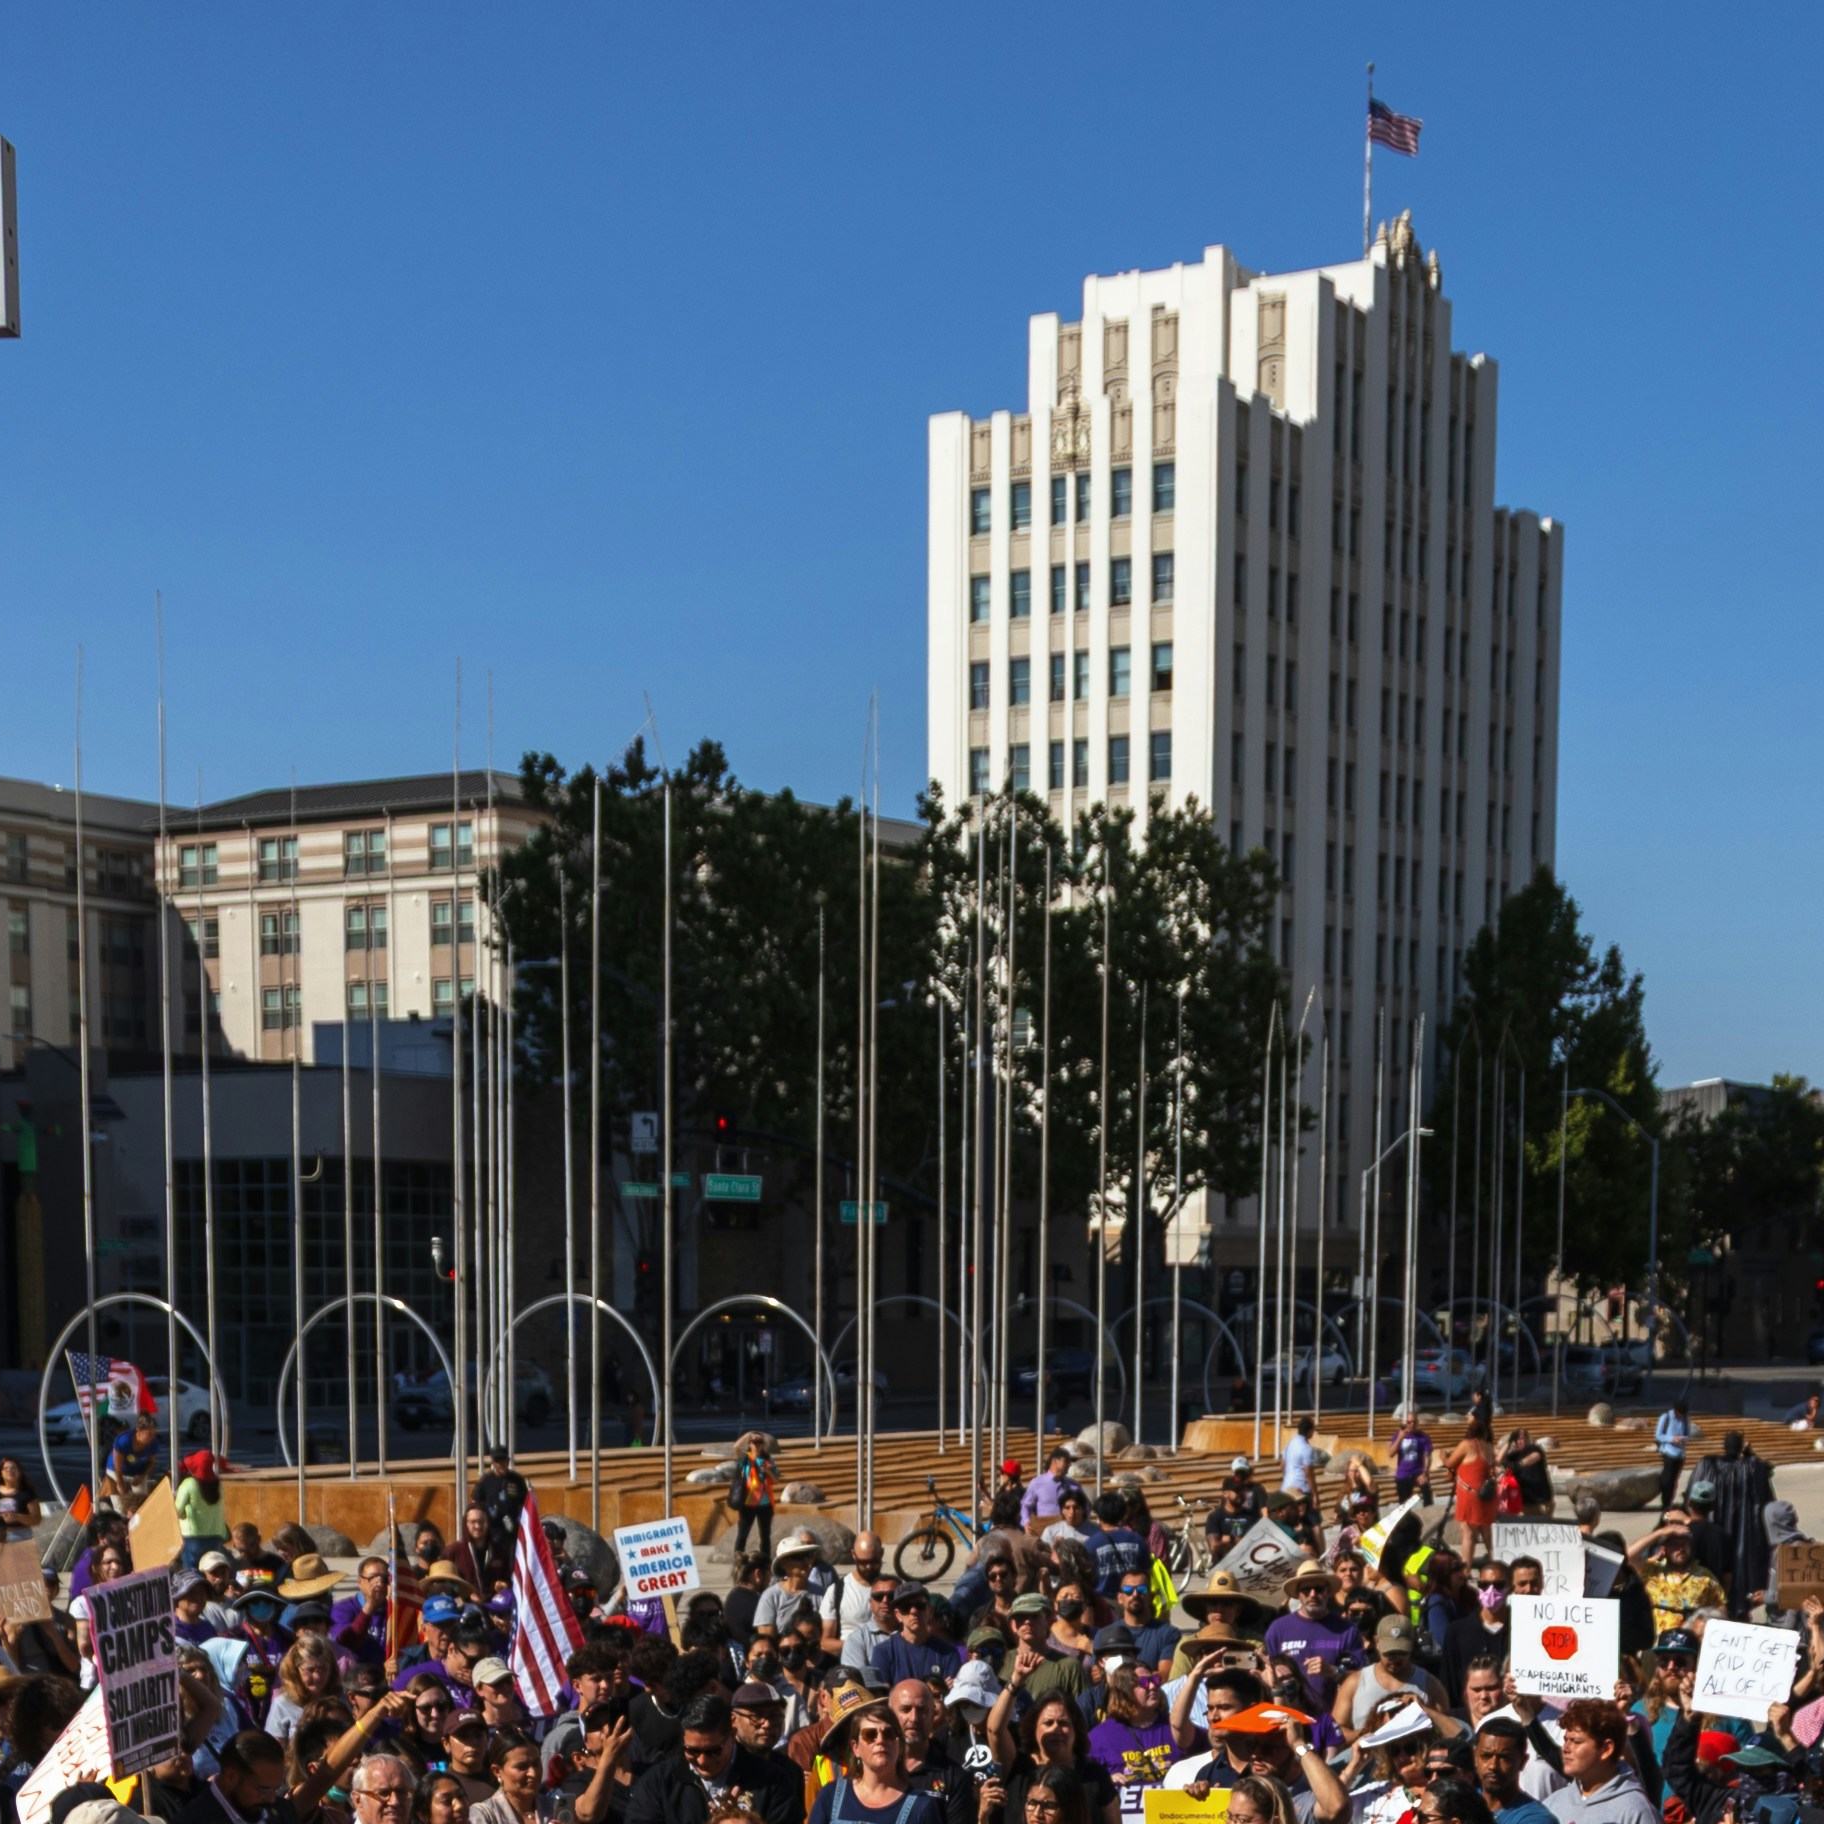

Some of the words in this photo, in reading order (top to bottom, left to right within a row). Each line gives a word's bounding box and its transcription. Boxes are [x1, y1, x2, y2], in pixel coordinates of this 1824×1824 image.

[619, 1523, 685, 1546] IMMIGRANTS
[639, 1543, 671, 1558] MAKE
[1544, 1551, 1562, 1571] IT
[628, 1555, 694, 1579] AMERICA
[636, 1569, 688, 1593] GREAT
[3, 1597, 43, 1619] LAND
[1533, 1603, 1555, 1622] NO
[1564, 1605, 1595, 1624] ICE
[98, 1616, 175, 1676] CAMPS
[1758, 1638, 1796, 1661] GET
[1714, 1652, 1746, 1672] RID
[1752, 1660, 1773, 1673] OF
[1514, 1668, 1588, 1684] SCAPEGOATING
[1702, 1675, 1729, 1696] ALL
[1736, 1678, 1757, 1693] OF
[1761, 1681, 1779, 1698] US
[107, 1669, 176, 1723] SOLIDARITY
[1538, 1680, 1602, 1696] IMMIGRANTS
[1159, 1812, 1215, 1820] Undocumented
